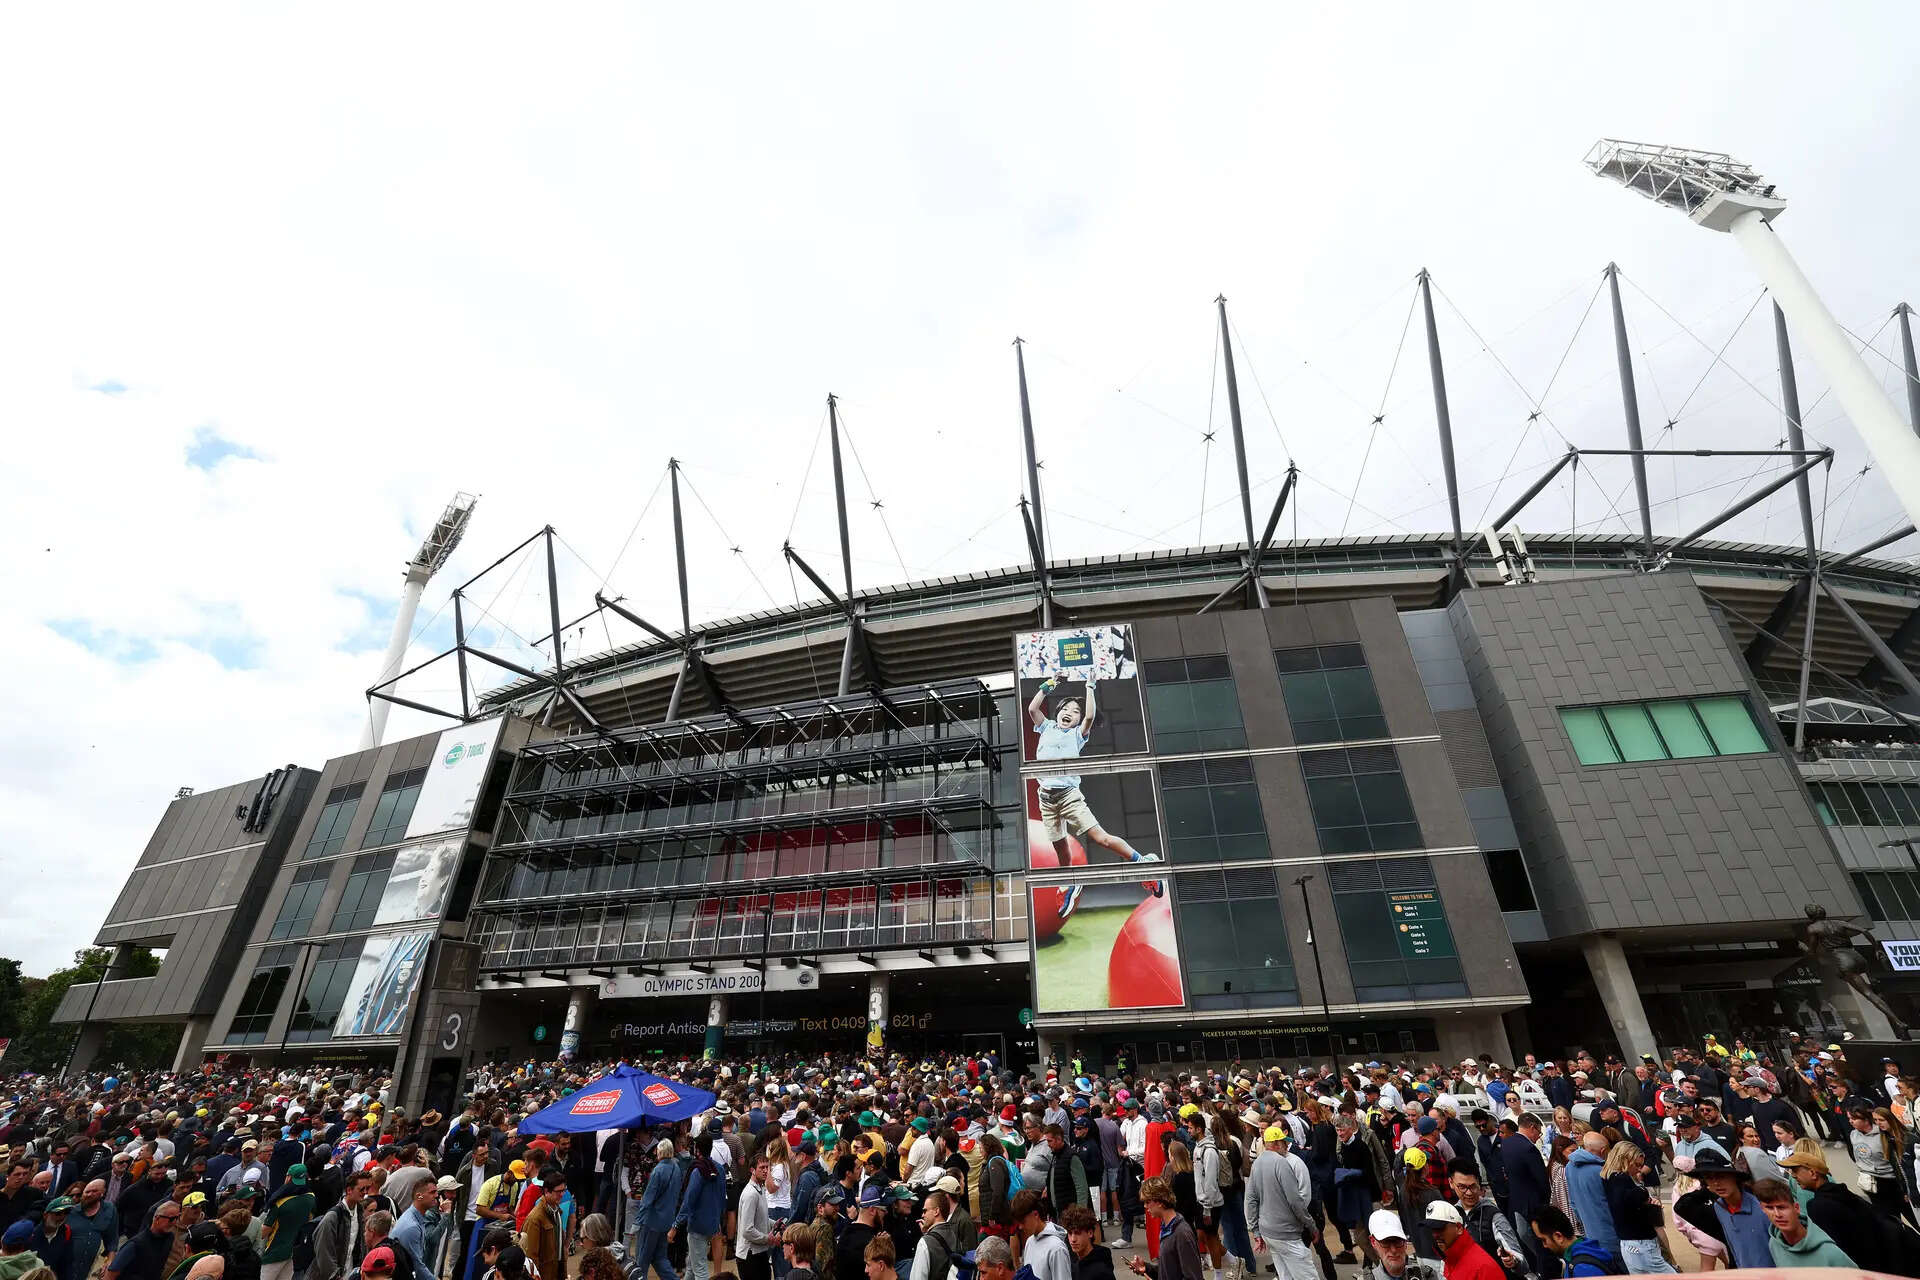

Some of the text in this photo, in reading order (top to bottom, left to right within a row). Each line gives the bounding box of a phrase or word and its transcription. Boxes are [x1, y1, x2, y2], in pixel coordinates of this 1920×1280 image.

[1888, 945, 1920, 955] YOU
[645, 975, 766, 992] OLYMPIC STAND 200
[564, 1005, 578, 1030] 3
[708, 999, 721, 1026] 3
[870, 993, 882, 1020] 3
[443, 1013, 461, 1050] 3
[624, 1023, 663, 1039] Report
[667, 1021, 706, 1036] Antiso
[800, 1017, 828, 1030] Text
[831, 1016, 866, 1029] 0409
[892, 1015, 916, 1027] 621
[579, 1098, 617, 1107] CHEMIST
